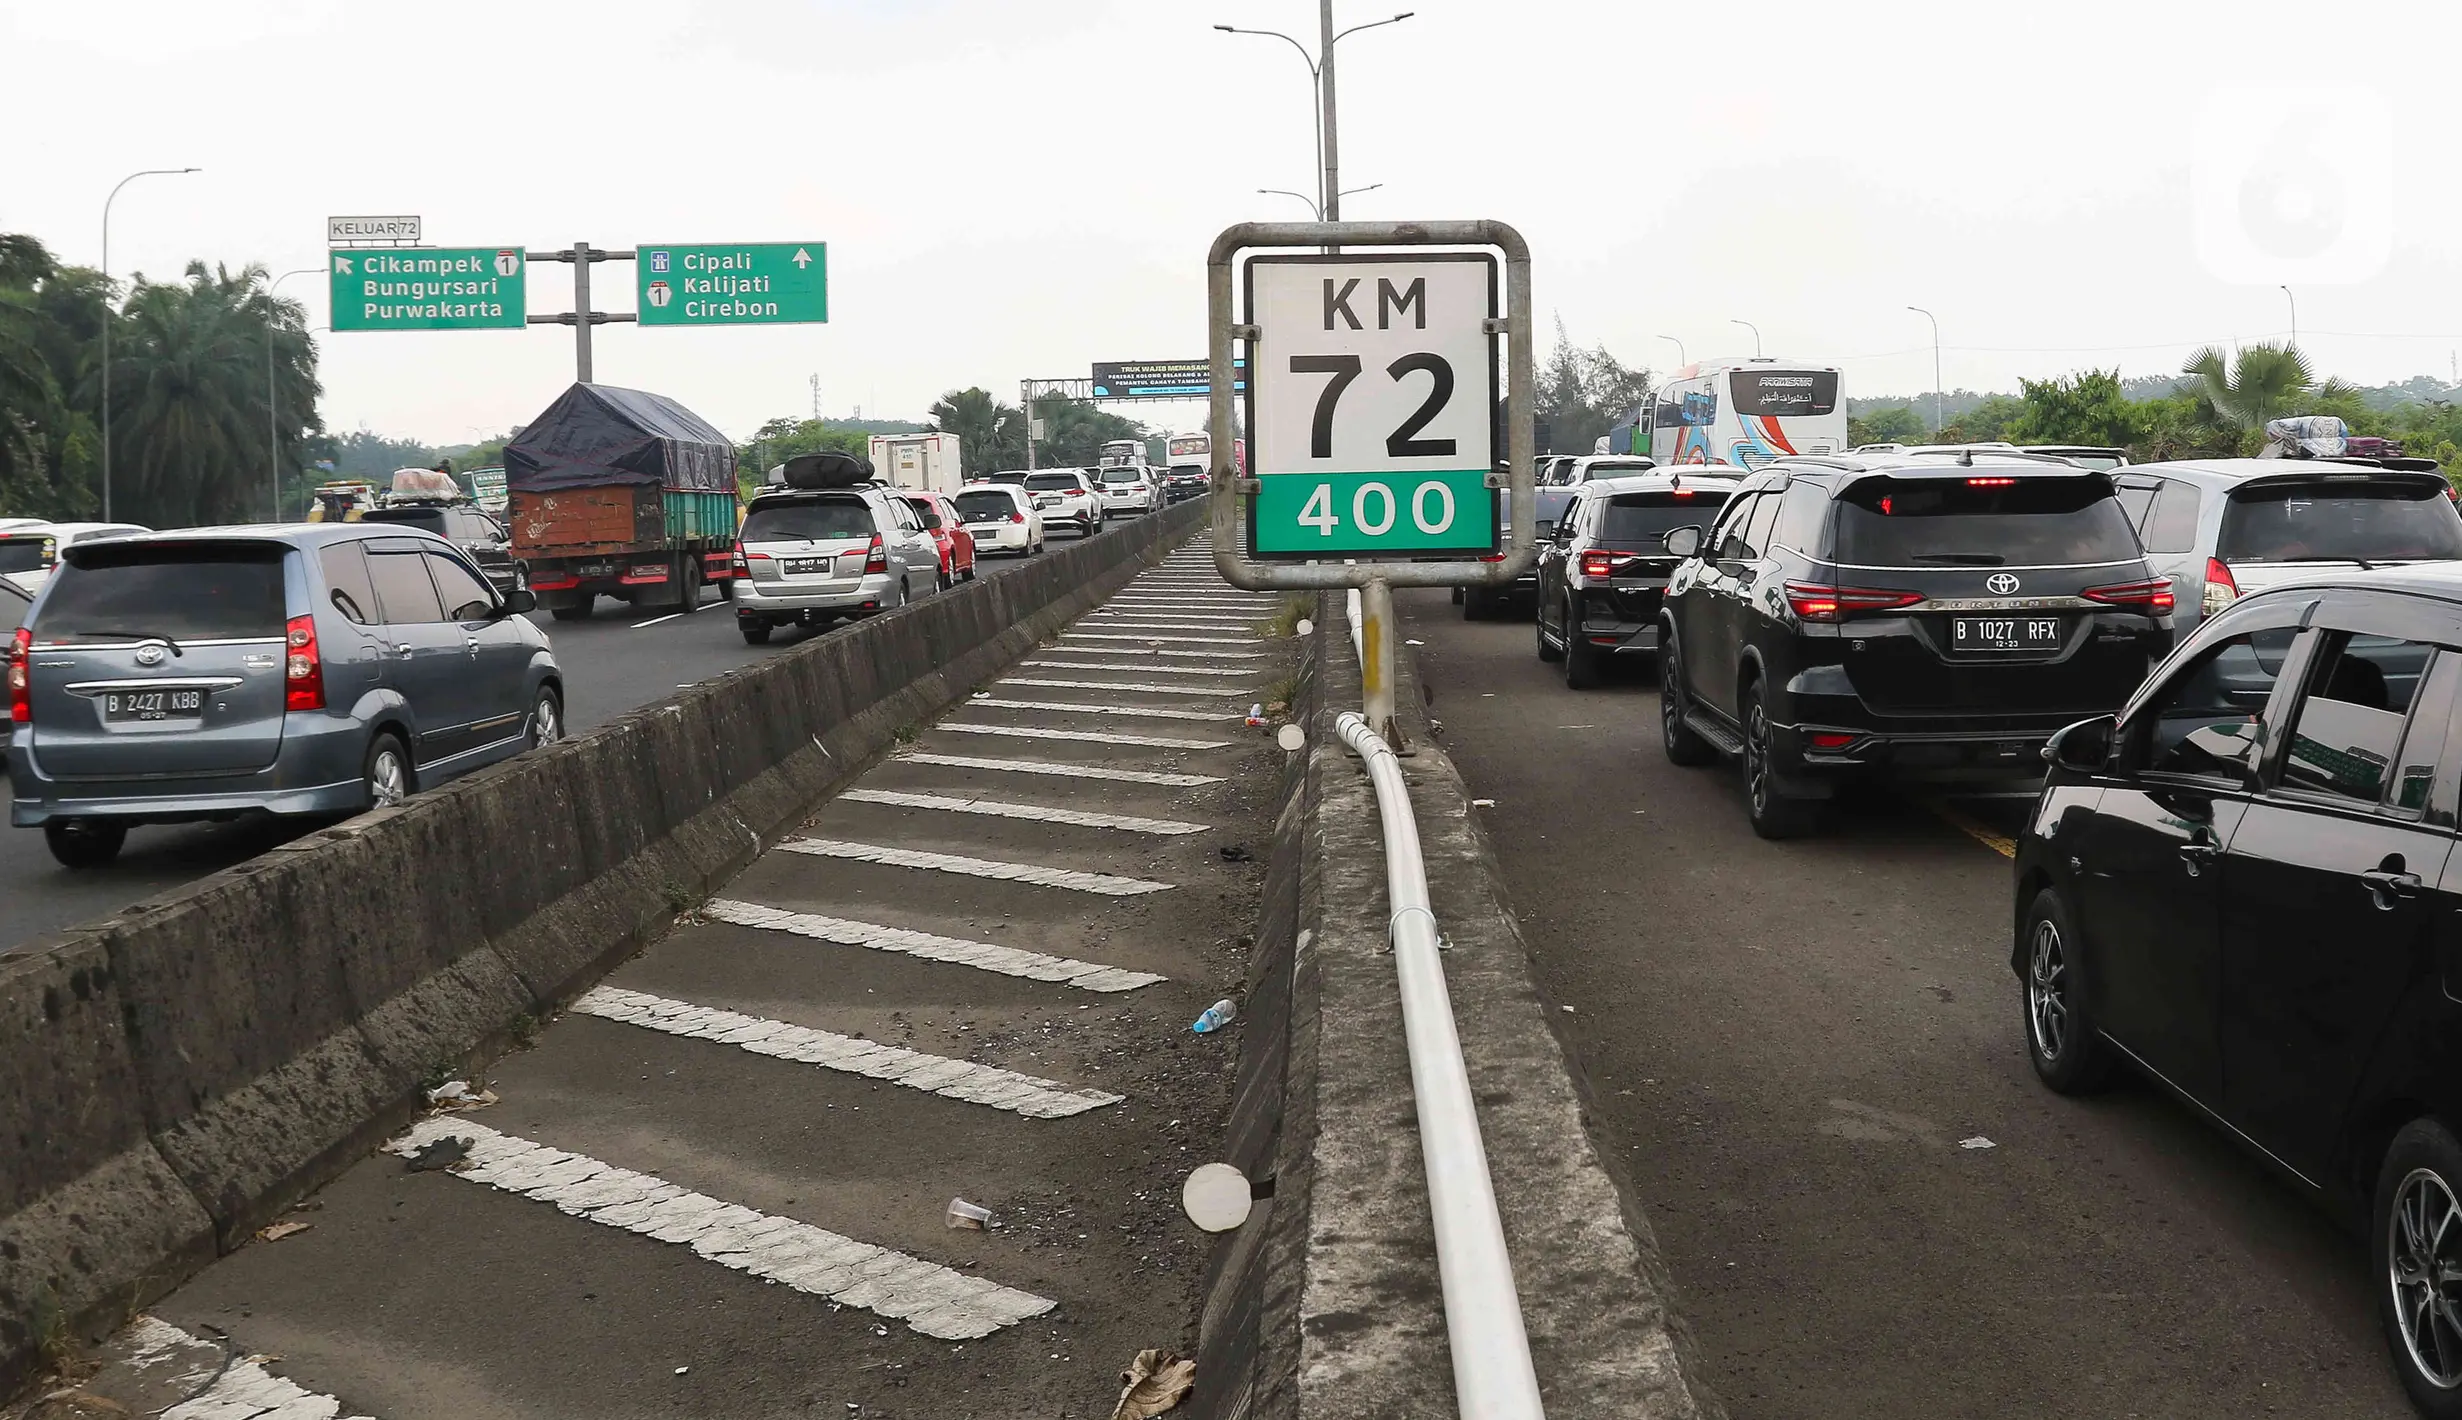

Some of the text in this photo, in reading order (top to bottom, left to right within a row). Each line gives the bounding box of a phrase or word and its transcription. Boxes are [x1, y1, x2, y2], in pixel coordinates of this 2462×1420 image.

[332, 222, 417, 235] KELUAR 72
[363, 255, 483, 276] Cikampek
[501, 257, 510, 275] 1
[683, 253, 752, 273] Cipali
[363, 278, 498, 300] Bungursari
[684, 275, 770, 297] Kalijati
[654, 287, 662, 305] 1
[1322, 277, 1426, 331] KM
[363, 301, 503, 319] Purwakarta
[685, 300, 779, 317] Cirebon
[1289, 352, 1457, 458] 72
[1296, 480, 1457, 537] 400
[1956, 621, 2056, 640] B 1027 RFX
[1995, 640, 2019, 648] 12-23
[108, 691, 200, 713] B 2427 KBB
[139, 711, 167, 721] 05-27
